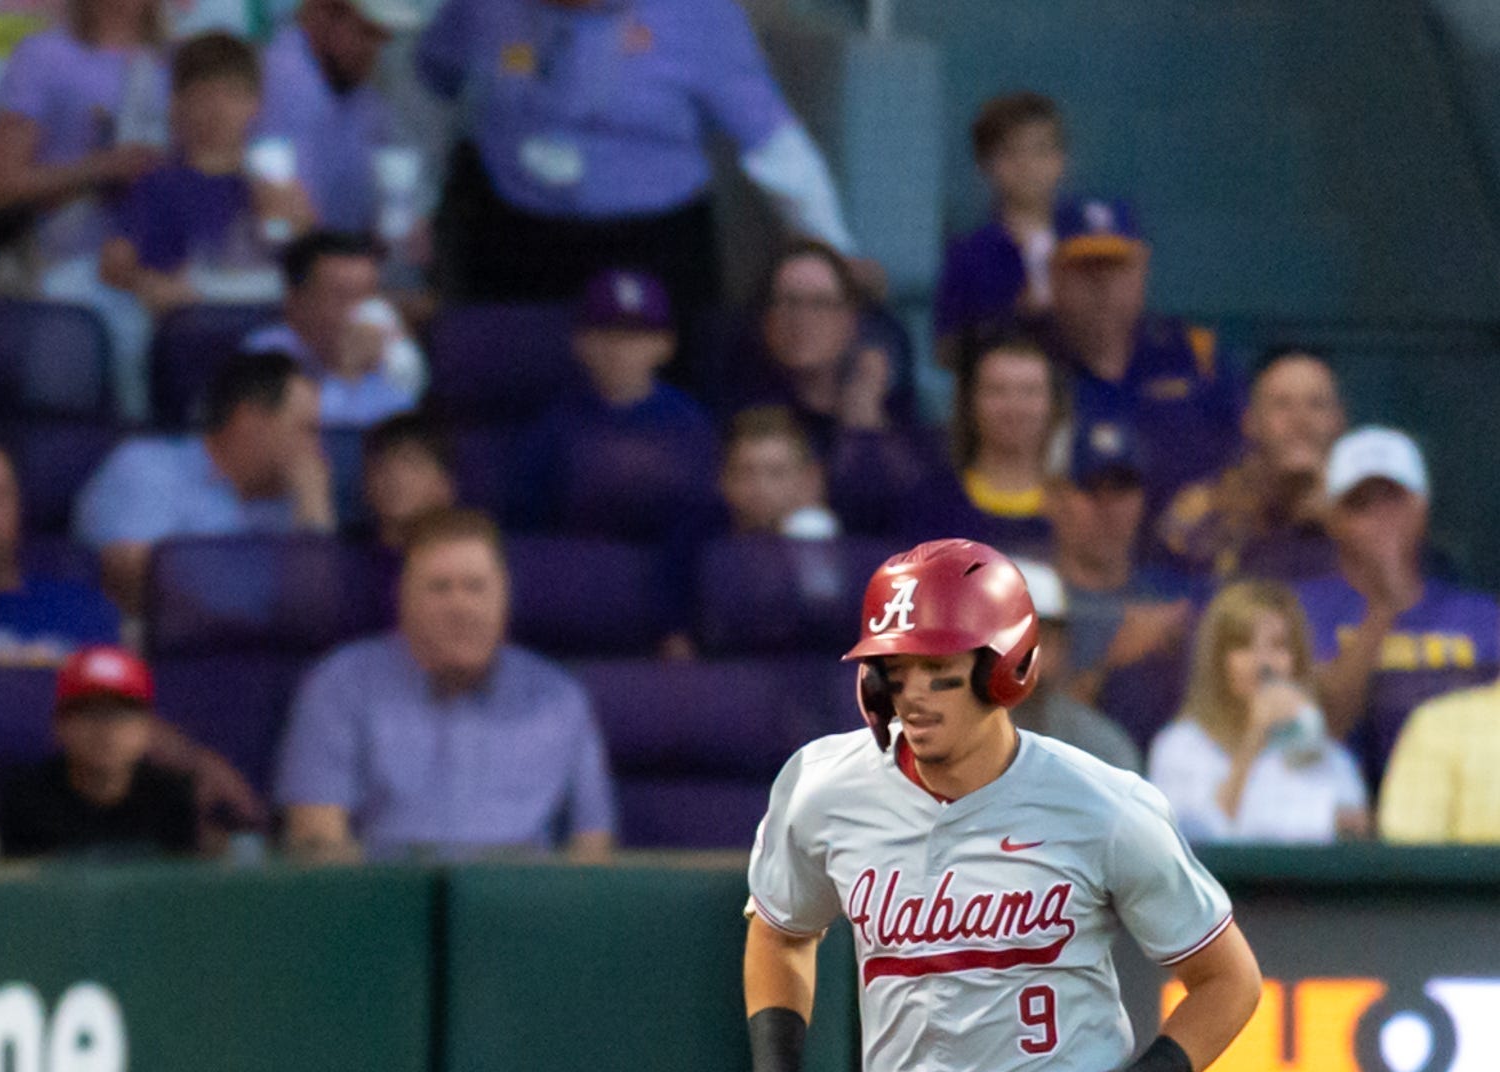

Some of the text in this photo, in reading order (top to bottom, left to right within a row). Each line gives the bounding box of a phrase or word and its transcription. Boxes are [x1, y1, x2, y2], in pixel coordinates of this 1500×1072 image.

[868, 578, 919, 634] A
[848, 867, 1076, 950] Alabama
[1018, 983, 1059, 1056] 9
